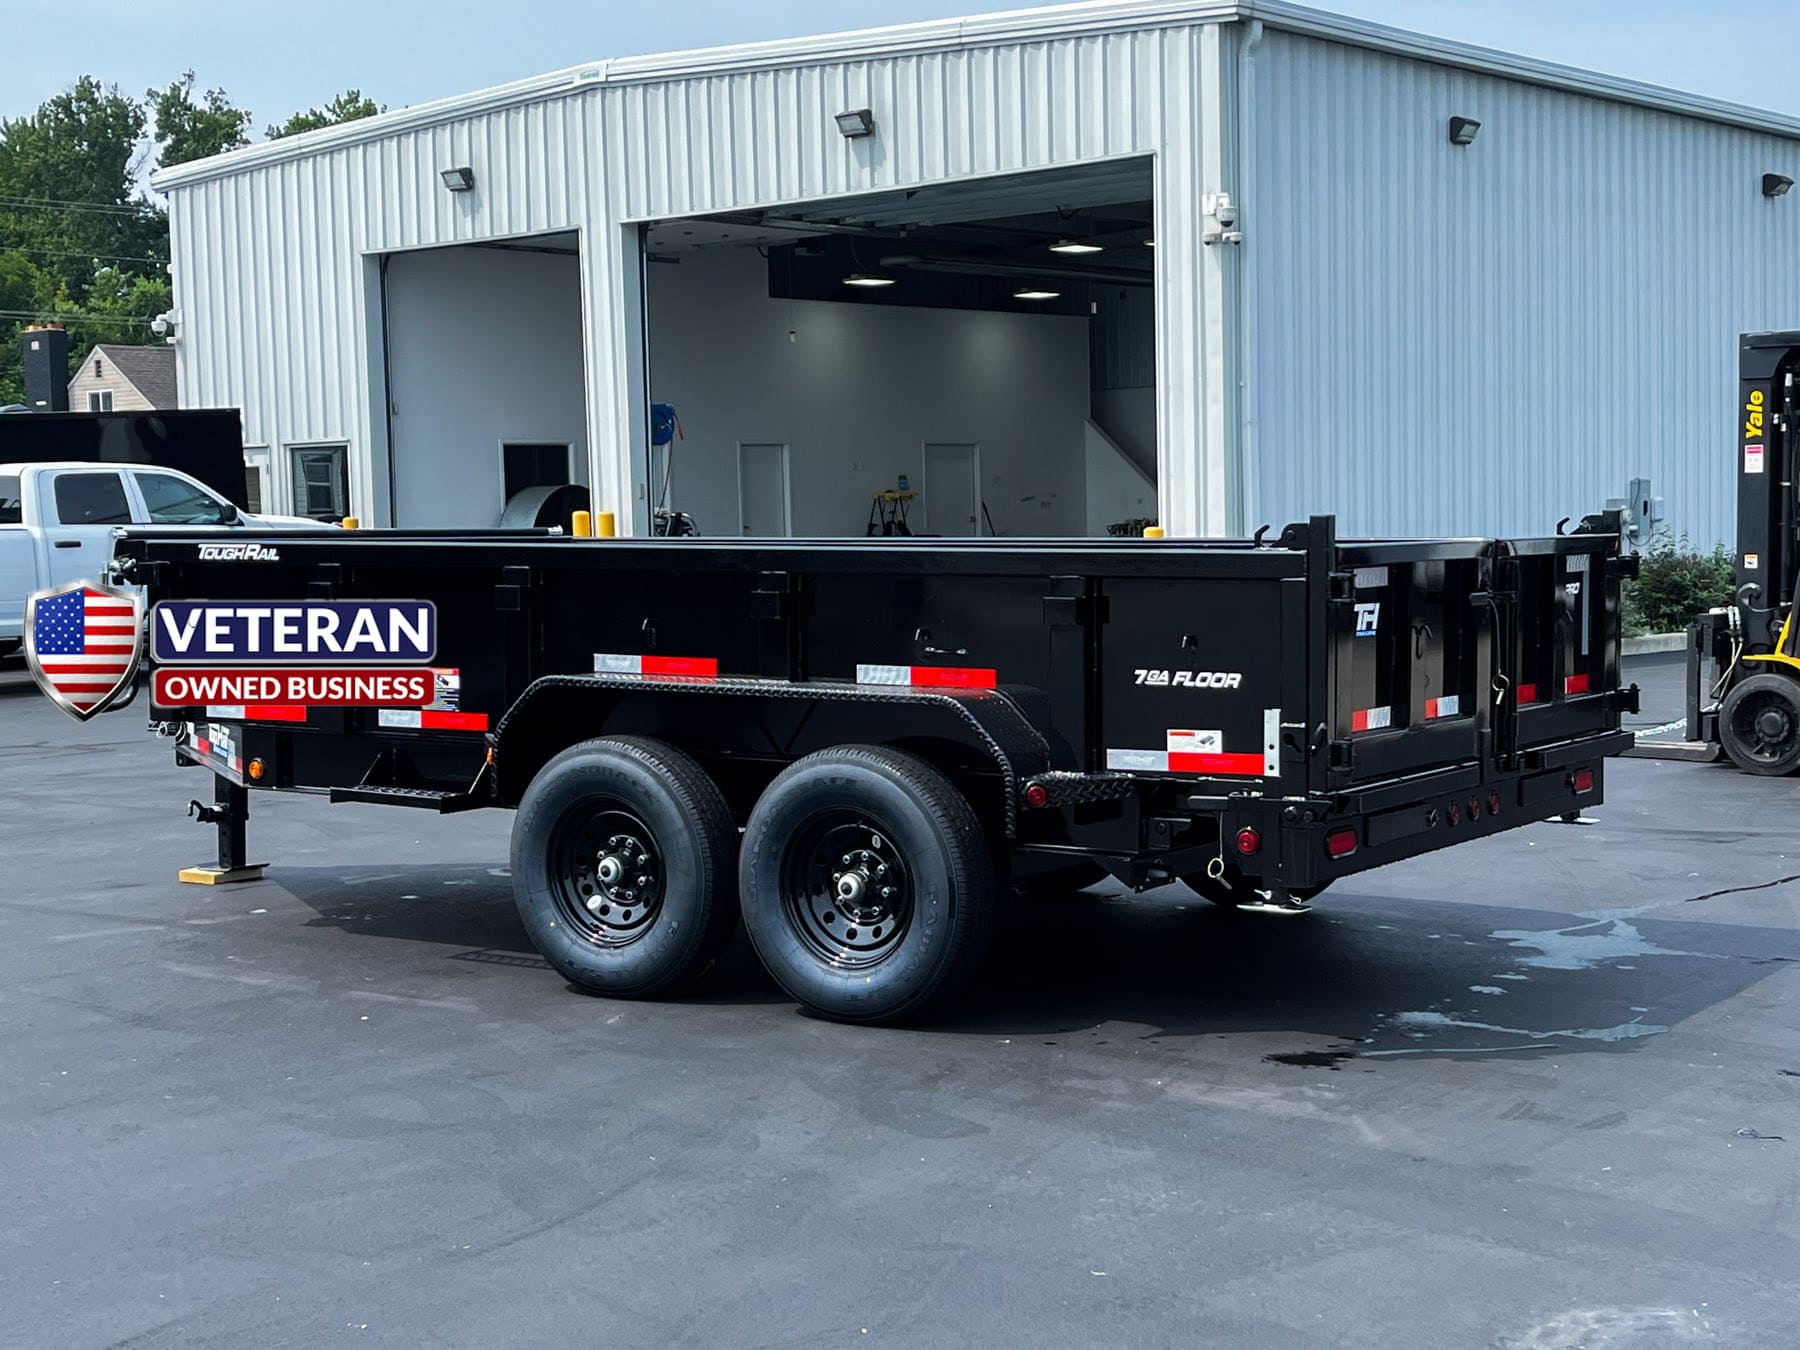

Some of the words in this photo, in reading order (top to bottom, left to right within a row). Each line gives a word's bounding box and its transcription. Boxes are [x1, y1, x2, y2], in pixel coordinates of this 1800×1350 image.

[1746, 390, 1764, 438] Yale
[1354, 603, 1380, 630] TH
[1172, 671, 1242, 688] FLOOR
